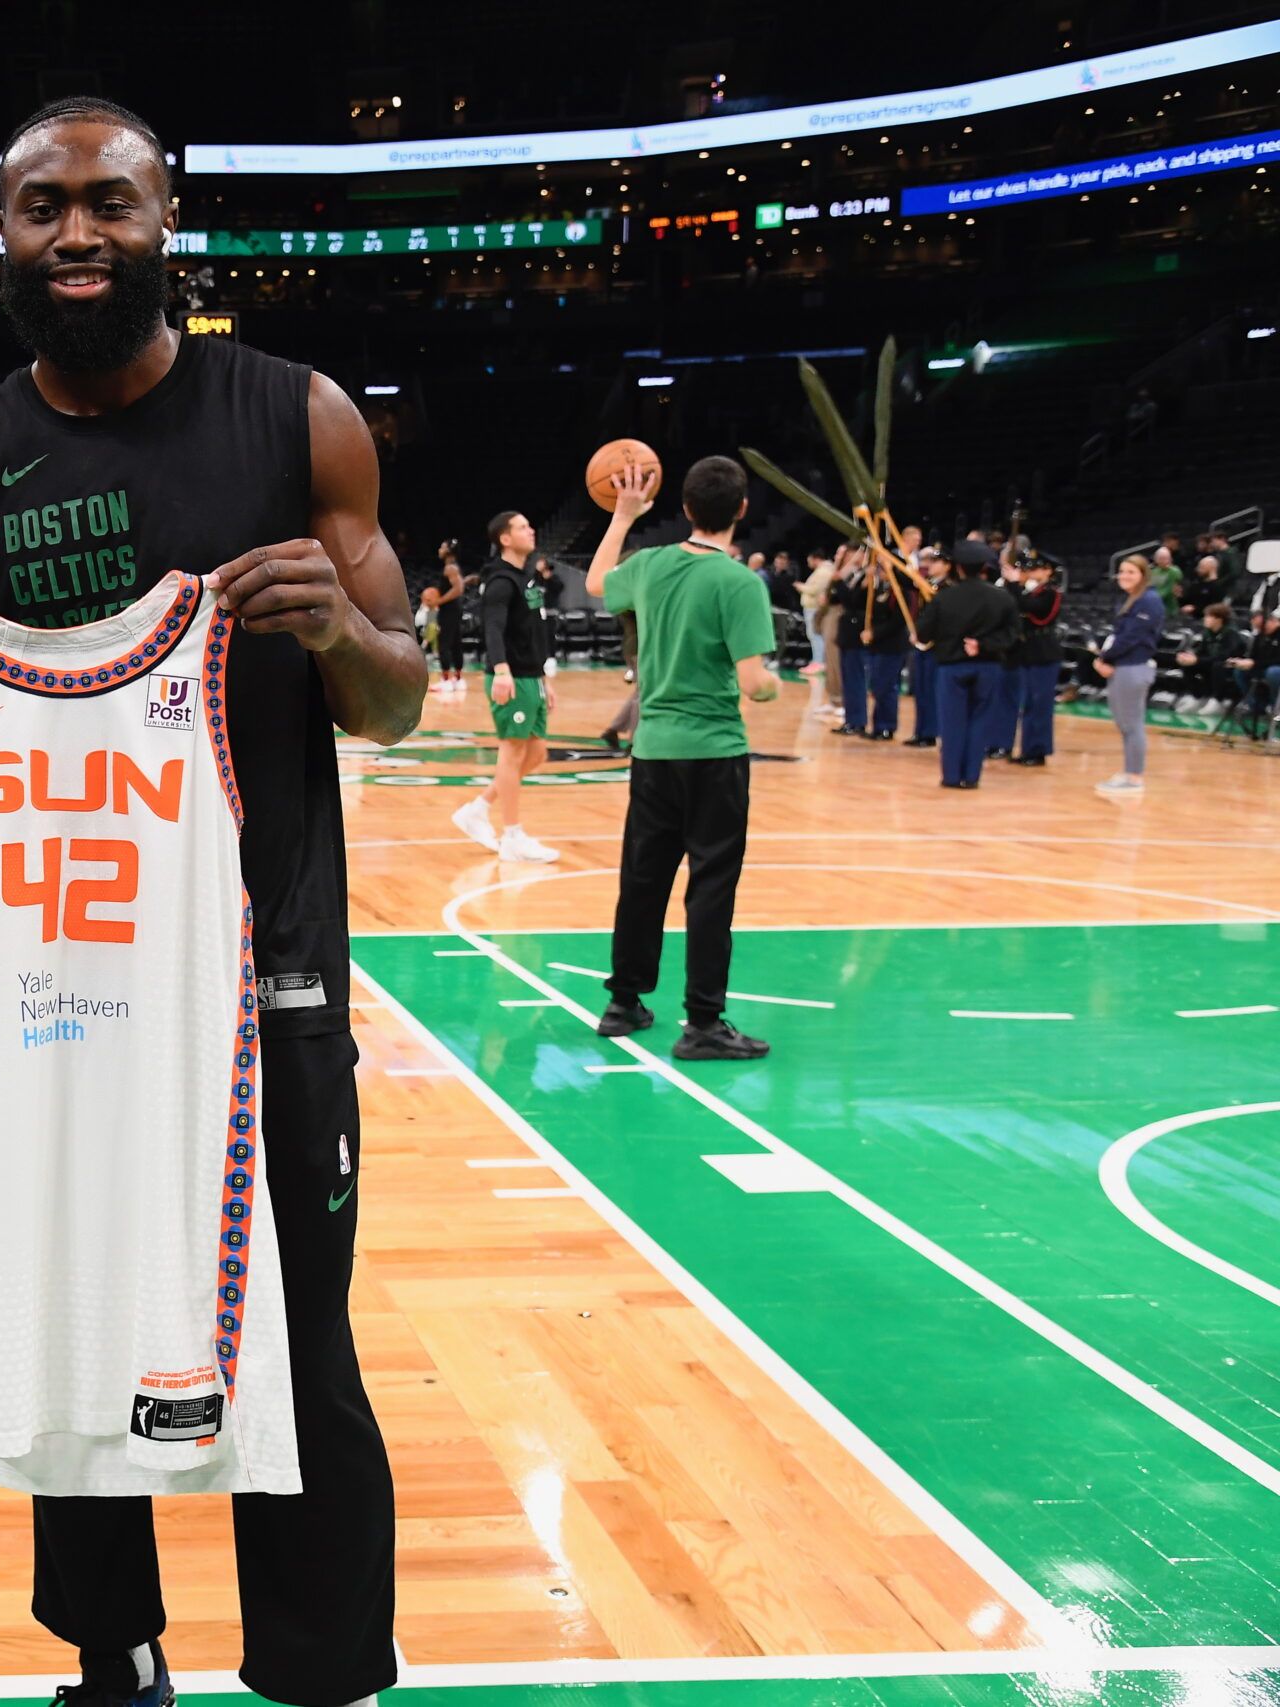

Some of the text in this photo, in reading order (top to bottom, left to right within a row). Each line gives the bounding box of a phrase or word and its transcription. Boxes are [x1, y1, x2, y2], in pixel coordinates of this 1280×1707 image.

[760, 206, 781, 224] TD
[785, 204, 820, 221] Bank
[864, 196, 891, 214] PM
[170, 232, 208, 254] STON
[3, 489, 130, 554] BOSTON
[9, 544, 137, 606] CELTICS
[148, 702, 192, 722] Post
[1, 837, 139, 943] 42
[18, 970, 53, 994] Yale
[23, 1019, 84, 1050] Health
